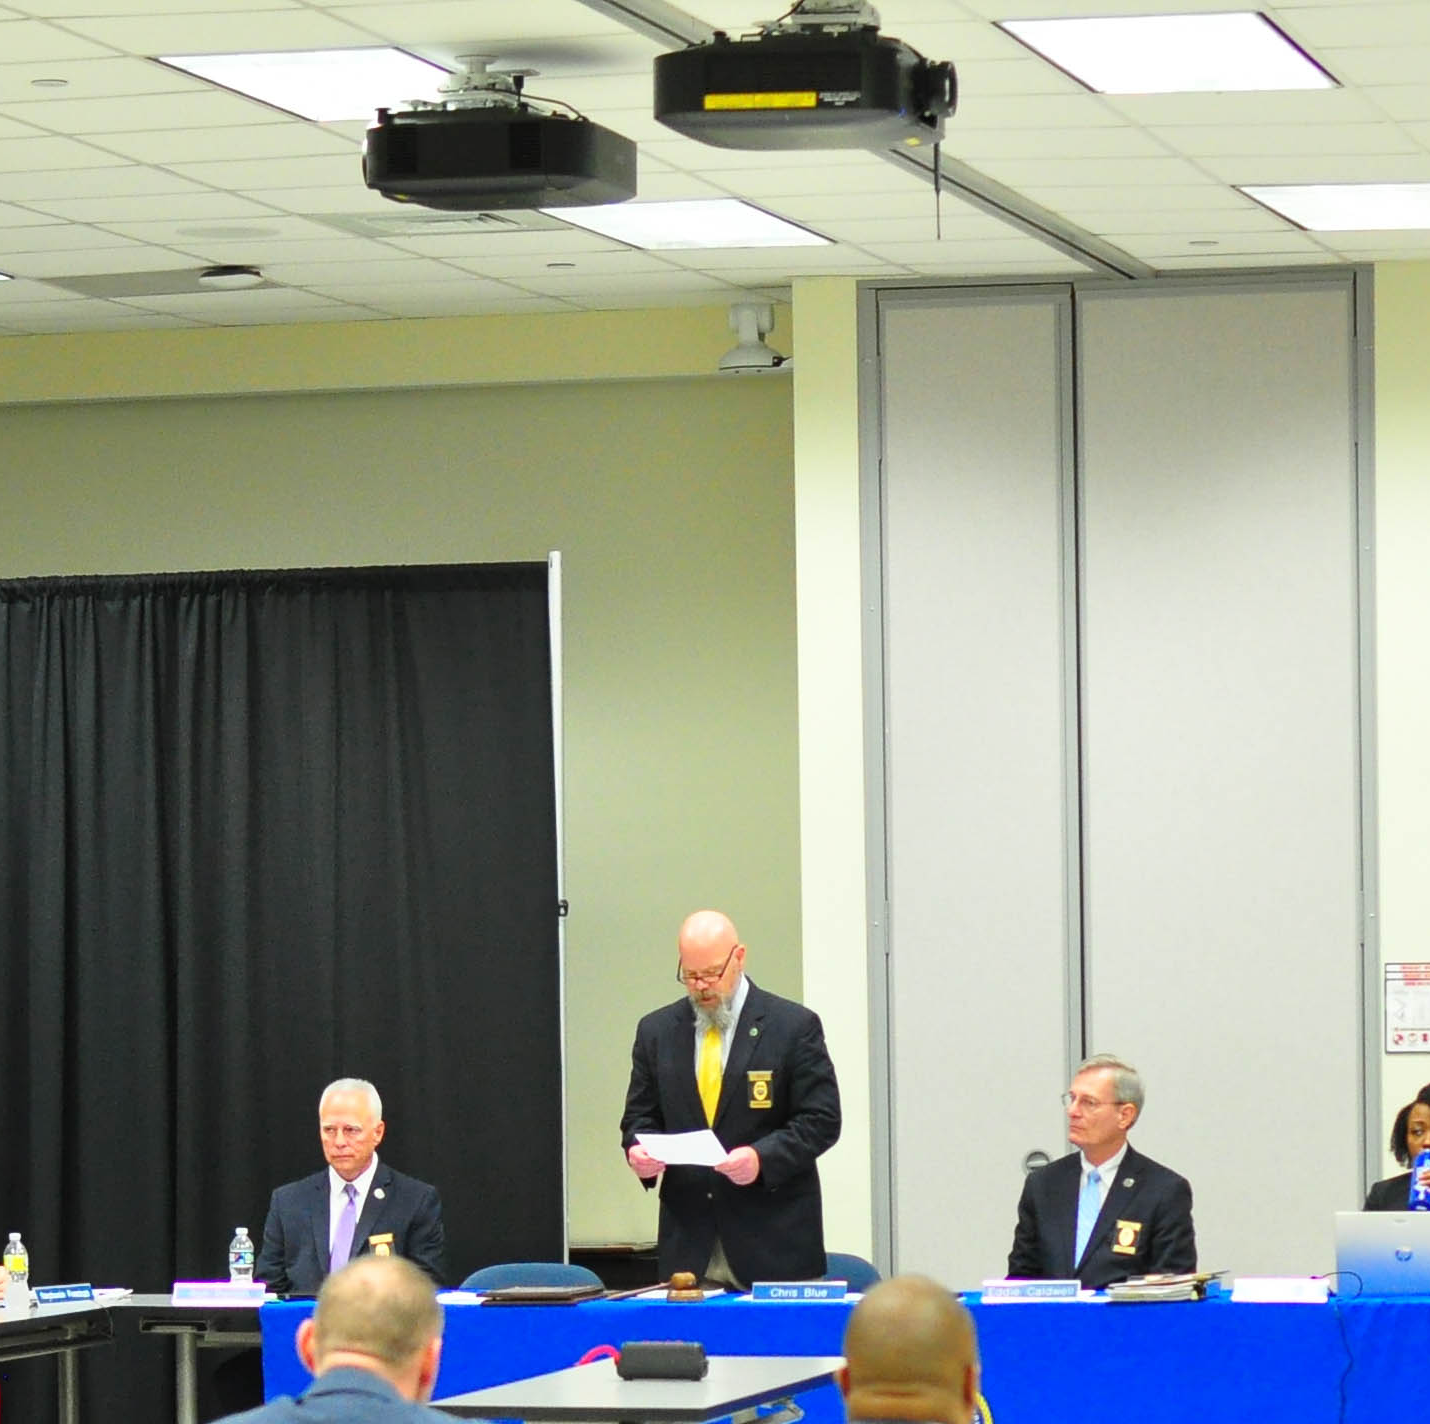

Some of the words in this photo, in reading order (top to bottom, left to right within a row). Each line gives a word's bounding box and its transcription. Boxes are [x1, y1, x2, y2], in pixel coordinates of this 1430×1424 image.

[770, 1287, 798, 1297] Chris
[803, 1287, 828, 1297] Blue
[1026, 1286, 1074, 1297] Caldwell
